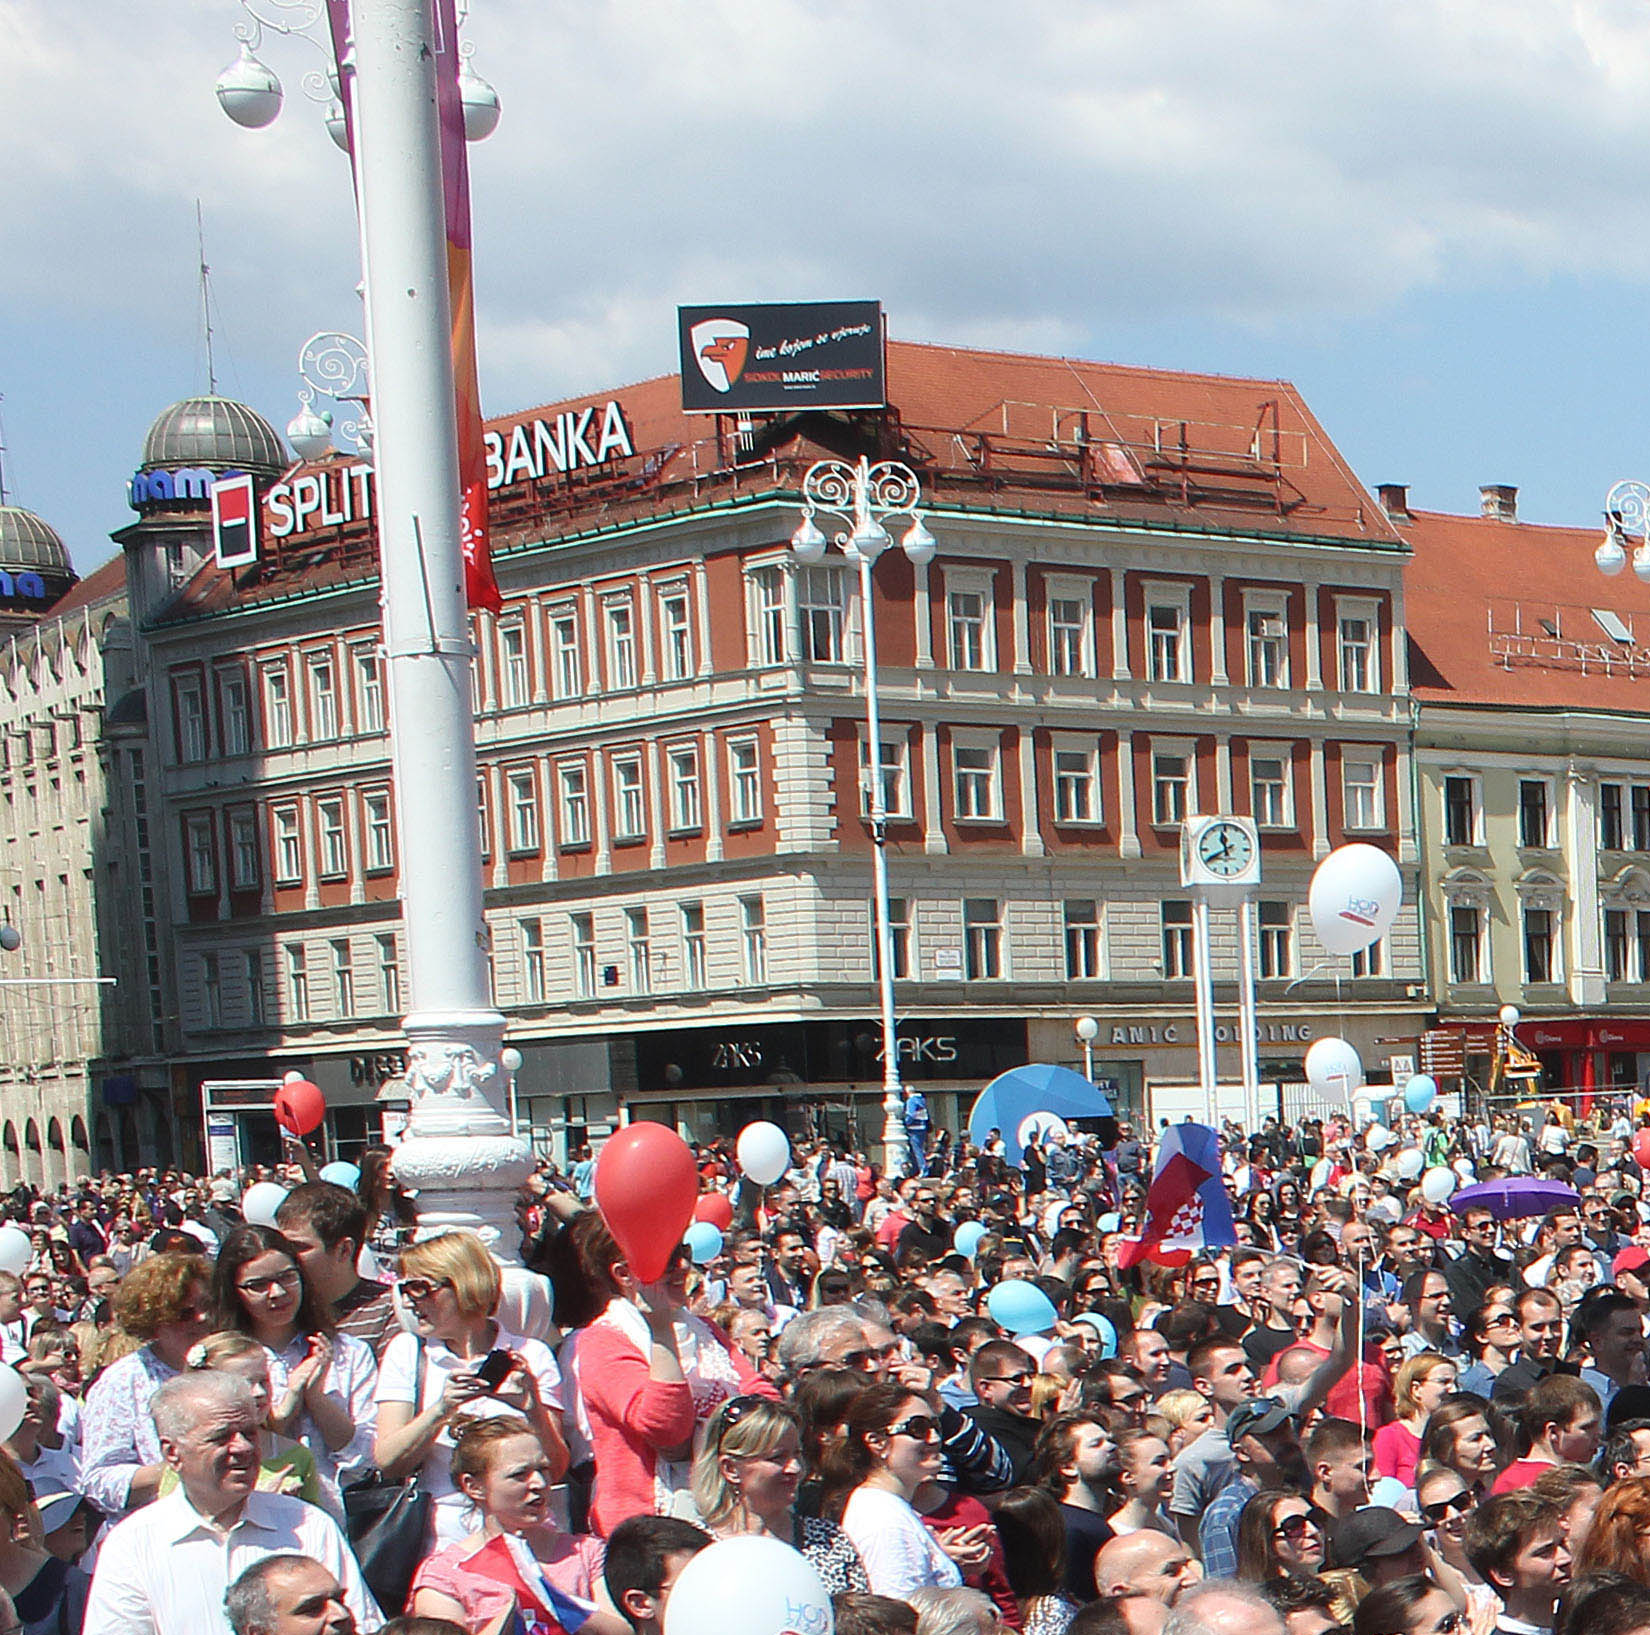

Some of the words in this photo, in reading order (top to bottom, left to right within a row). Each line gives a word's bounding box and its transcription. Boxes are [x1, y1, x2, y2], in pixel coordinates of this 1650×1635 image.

[782, 368, 821, 383] MARIĆ
[131, 467, 248, 504] nam
[1111, 1023, 1179, 1043] ANIĆ
